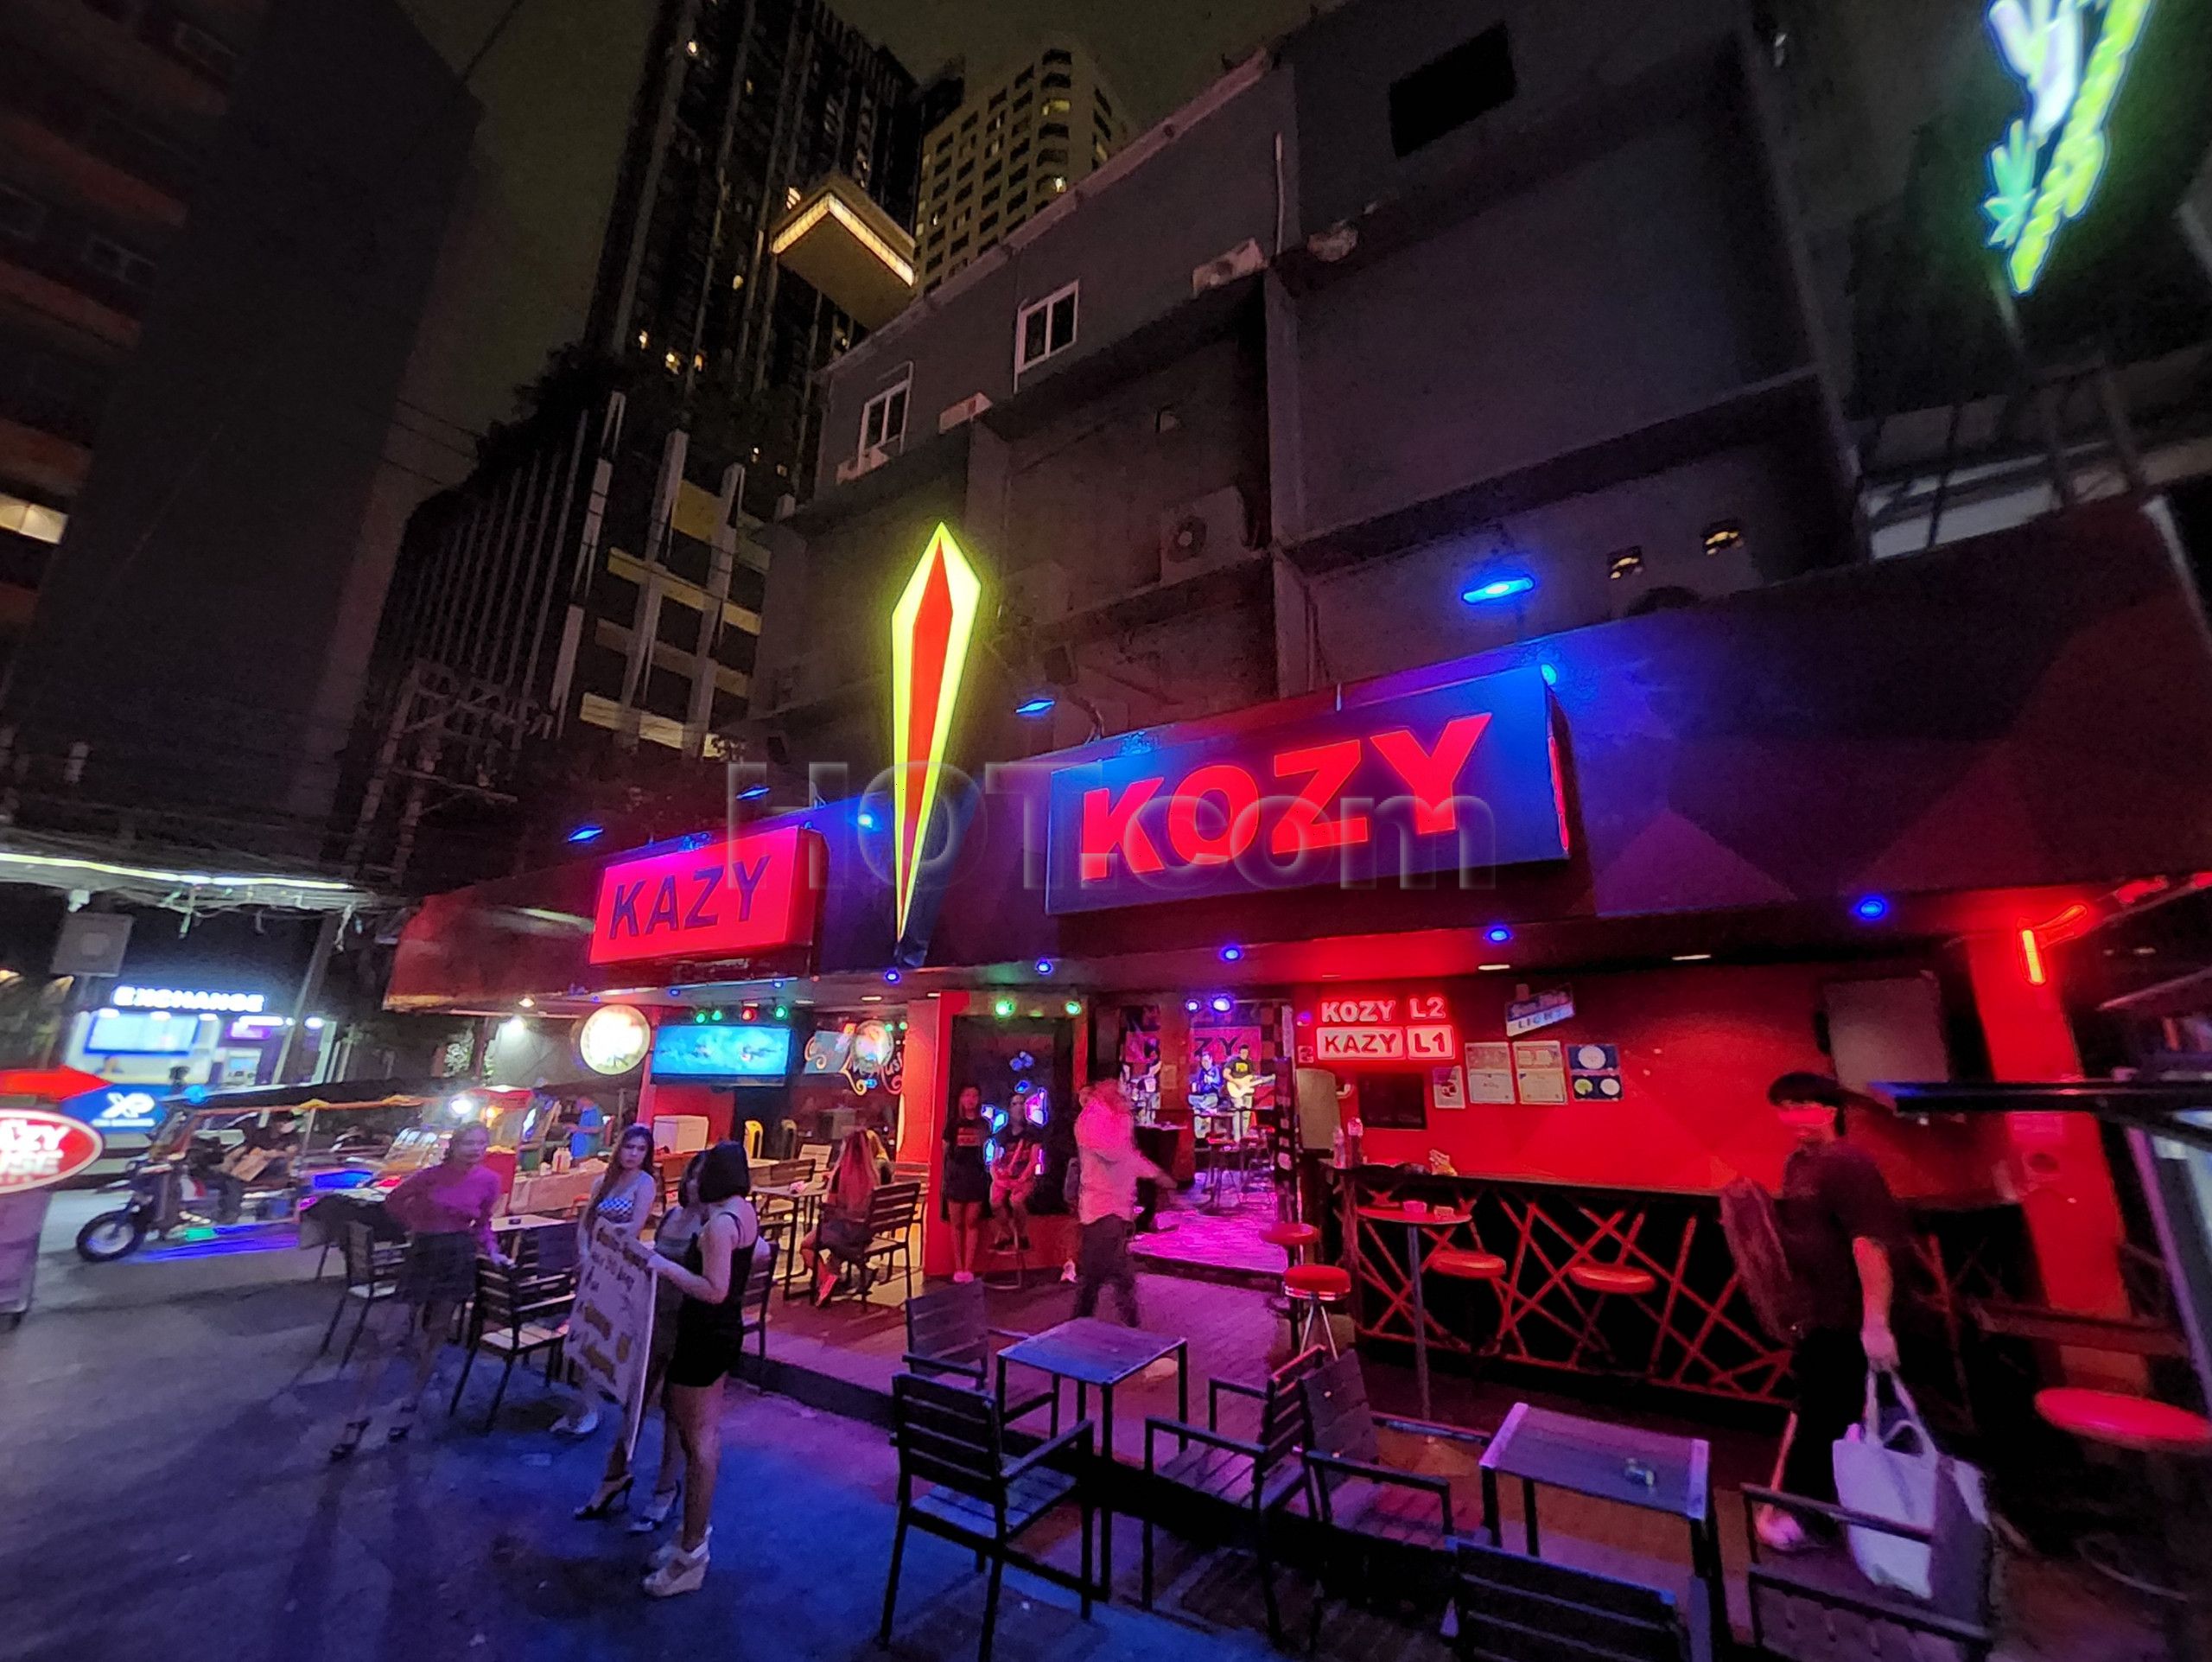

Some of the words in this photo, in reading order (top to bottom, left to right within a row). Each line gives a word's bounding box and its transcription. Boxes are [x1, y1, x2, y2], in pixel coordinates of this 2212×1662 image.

[1081, 712, 1493, 884] KOZY
[609, 854, 772, 940] KAZY
[1320, 999, 1397, 1023] KOZY
[1409, 996, 1446, 1020] L2
[1324, 1033, 1397, 1054] KAZY
[1414, 1032, 1446, 1053] L1
